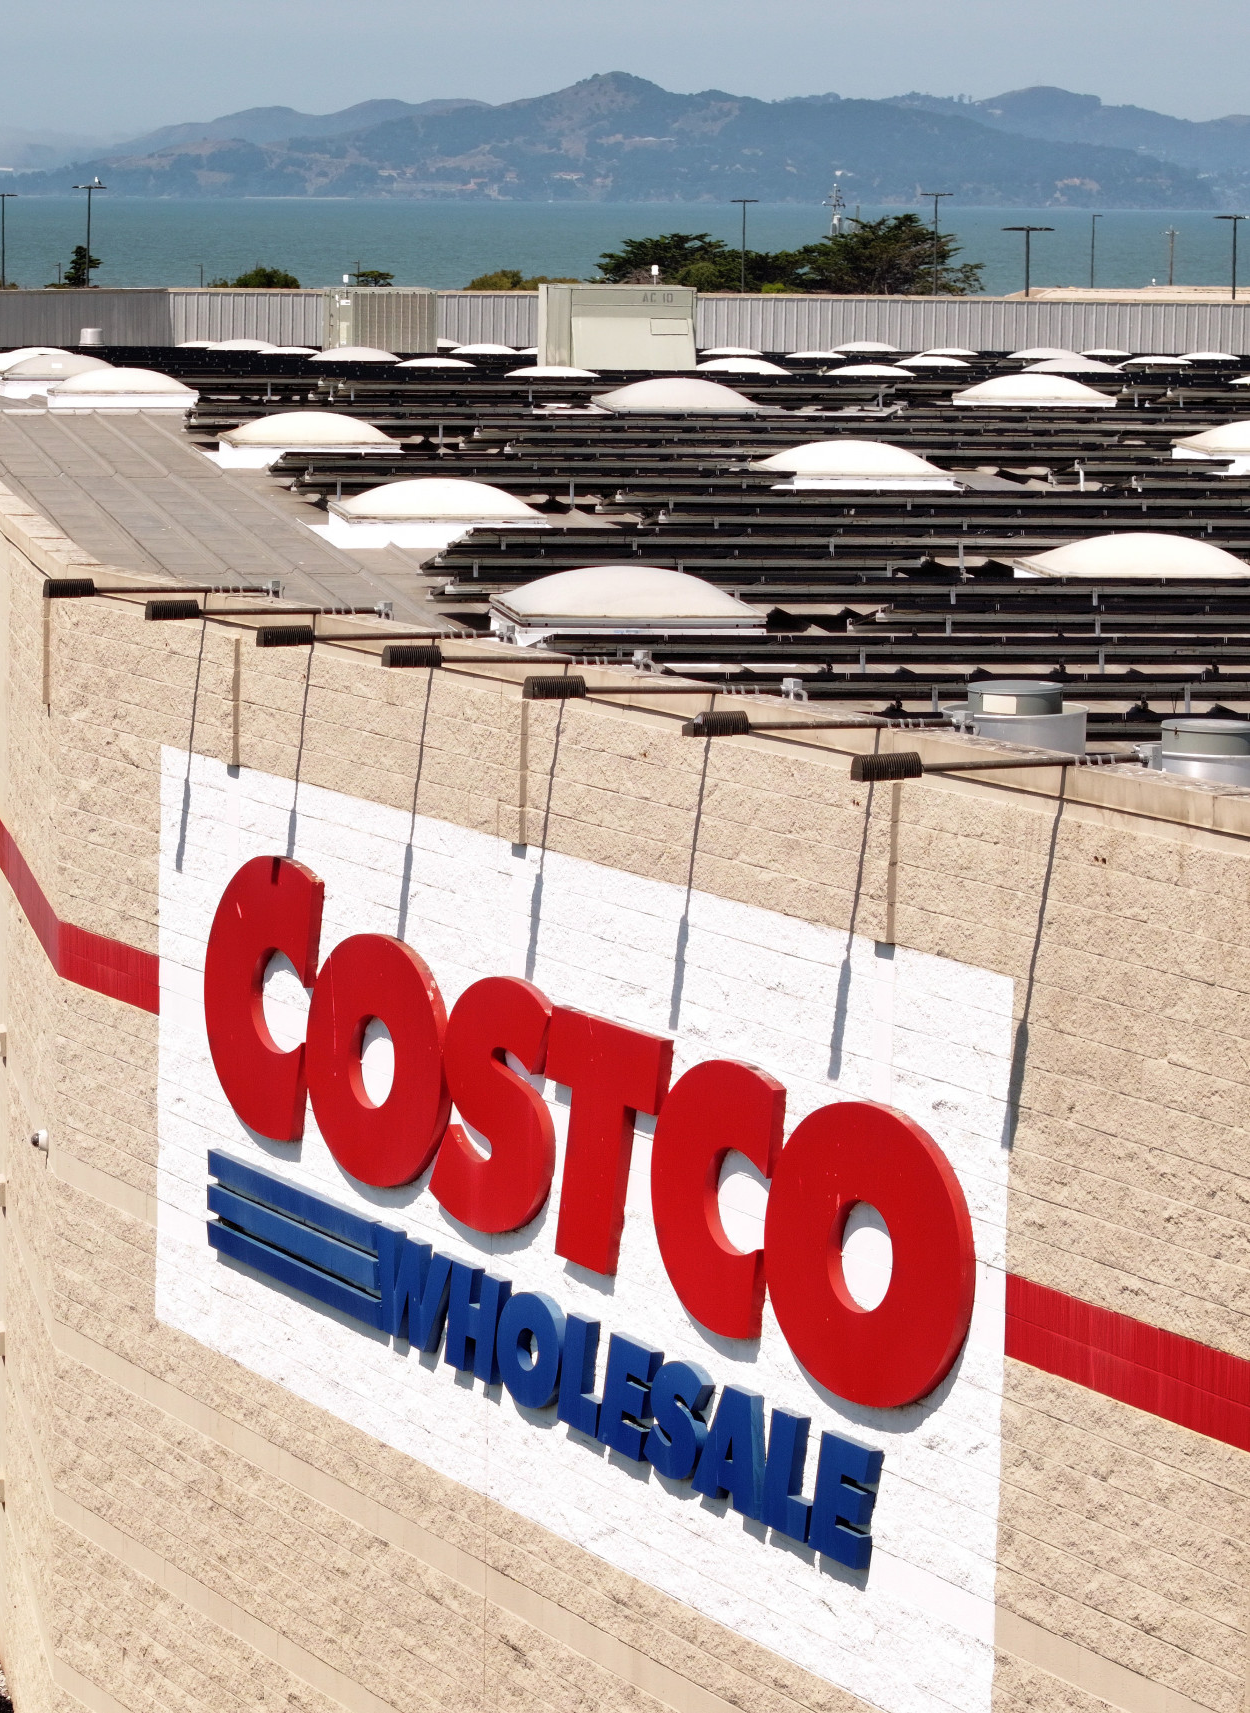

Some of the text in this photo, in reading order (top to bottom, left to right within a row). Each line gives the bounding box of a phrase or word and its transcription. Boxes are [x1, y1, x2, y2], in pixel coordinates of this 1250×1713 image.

[642, 292, 657, 303] AC
[204, 856, 975, 1407] COSTCO
[377, 1221, 885, 1570] WHOLESALE
